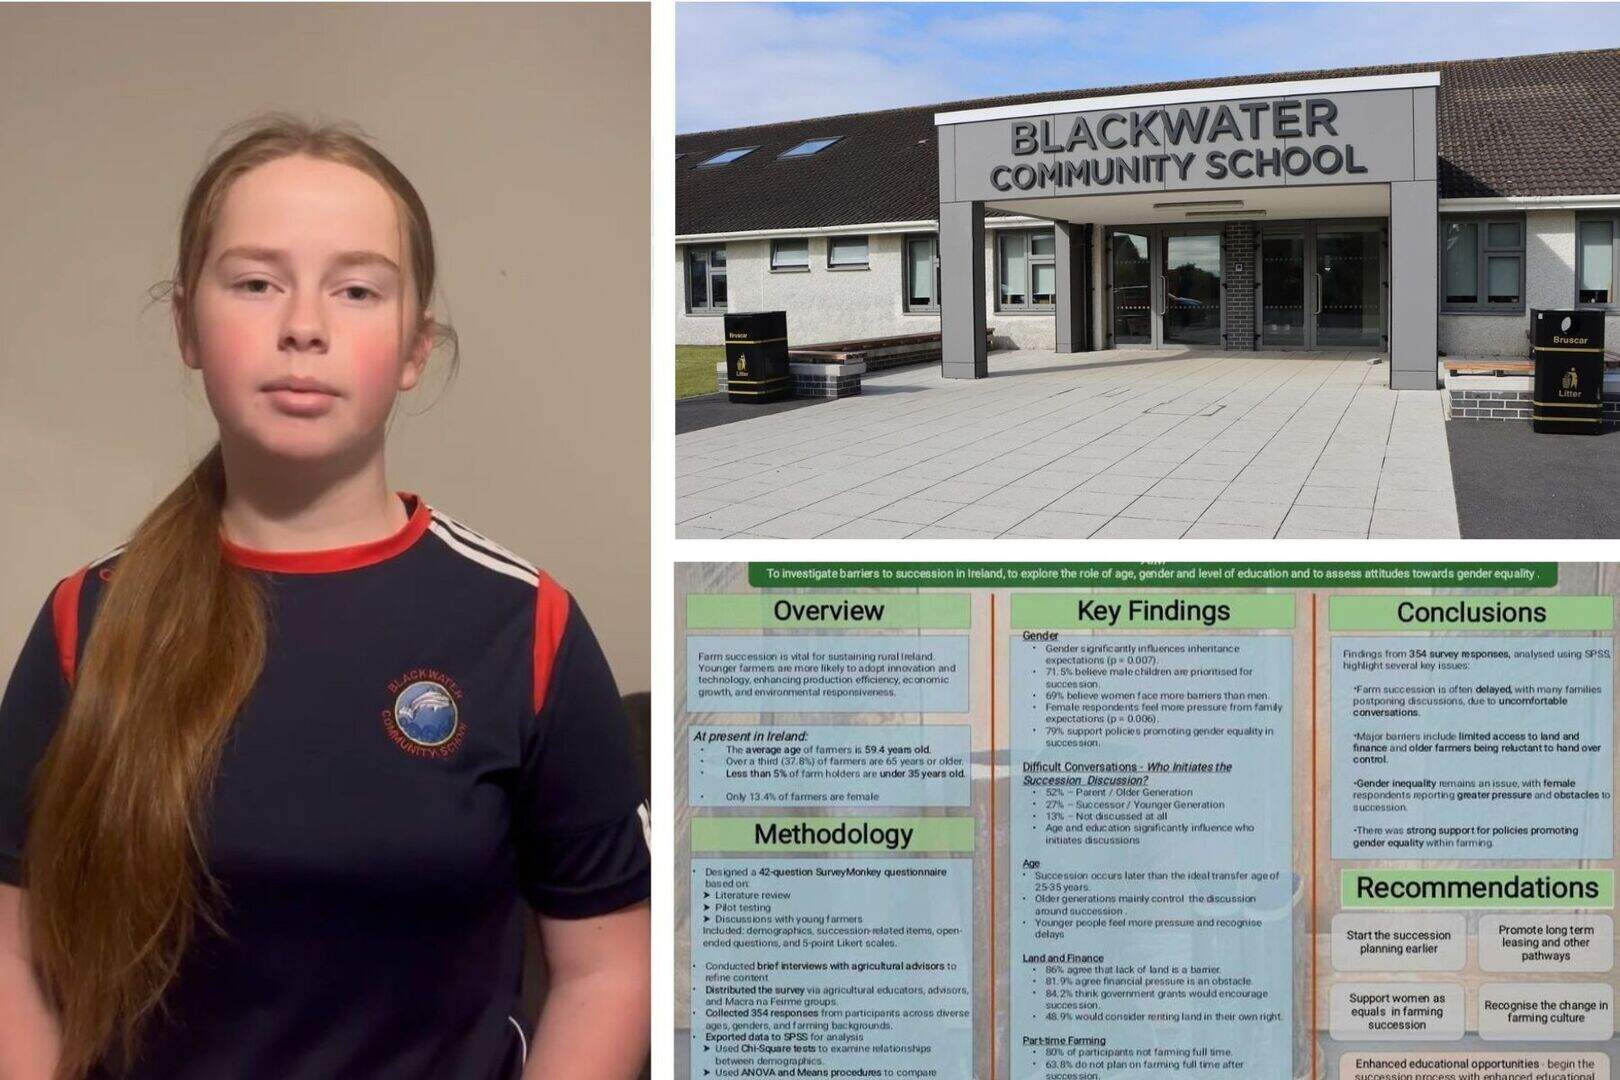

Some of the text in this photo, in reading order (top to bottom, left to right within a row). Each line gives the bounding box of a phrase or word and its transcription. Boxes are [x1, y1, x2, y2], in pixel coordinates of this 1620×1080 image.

[1011, 98, 1338, 156] BLACKWATER
[990, 143, 1367, 192] COMMUNITY SCHOOL
[1553, 336, 1589, 344] Bruscar
[1558, 390, 1582, 398] Litter
[767, 568, 1533, 580] To investigate barriers to succession in Ireland, to explore the role of age, gender and level of education and to assess attitudes towards gender equality
[774, 600, 885, 621] Overview
[1078, 600, 1230, 625] Key Findings
[1397, 601, 1546, 623] Conclusions
[1023, 631, 1059, 642] Gender
[387, 669, 464, 698] BLACKWATER
[693, 731, 809, 743] At present in Ireland:
[726, 745, 931, 755] The average age of farmers is 59.4 years old.
[1353, 744, 1387, 752] finance
[1390, 744, 1407, 752] and
[1409, 744, 1432, 752] older
[1434, 744, 1471, 752] farmers
[1474, 744, 1499, 753] being
[1501, 744, 1542, 752] reluctant
[1556, 744, 1579, 752] hand
[1023, 762, 1232, 773] Difficult Conversations Who Initiates the
[726, 769, 748, 778] Less
[750, 769, 771, 778] than
[773, 769, 788, 778] 5%
[789, 769, 798, 778] of
[800, 769, 823, 778] farm
[825, 769, 860, 778] holders
[880, 769, 905, 778] under
[908, 769, 920, 778] 35
[921, 771, 947, 779] years
[949, 769, 965, 778] old.
[1023, 775, 1149, 786] Succession Discussion?
[726, 792, 746, 802] Only
[750, 792, 776, 801] 13.4%
[778, 792, 789, 801] of
[791, 792, 827, 801] farmers
[847, 792, 879, 801] female
[1045, 823, 1255, 834] Age and education significantly influence who
[755, 823, 913, 849] Methodology
[1353, 838, 1493, 848] gender equality within farming.
[1023, 859, 1040, 869] Age
[705, 868, 748, 878] Designed
[759, 868, 813, 878] 42-question
[816, 868, 881, 878] SurveyMonkey
[884, 868, 947, 878] questionnaire
[1357, 875, 1599, 898] Recommendations
[715, 914, 863, 925] Discussions with young farmers
[1347, 930, 1451, 940] Start the succession
[1499, 925, 1594, 936] Promote long term
[1360, 944, 1438, 954] planning earlier
[1502, 938, 1590, 949] leasing and other
[1023, 954, 1104, 964] Land and Finance
[1522, 950, 1570, 962] pathways
[705, 985, 756, 994] Distributed
[758, 985, 772, 994] the
[775, 987, 805, 996] survey
[823, 986, 874, 996] agricultural
[877, 986, 926, 995] educators,
[928, 986, 969, 995] advisors,
[1349, 993, 1445, 1004] Support women as
[1484, 1000, 1608, 1011] Recognise the change in
[1351, 1007, 1443, 1018] equals in farming
[1508, 1013, 1585, 1024] farming culture
[1368, 1020, 1426, 1030] succession
[1023, 1036, 1106, 1047] Part-time Farming
[1356, 1059, 1595, 1069] Enhanced educational opportunities begin the
